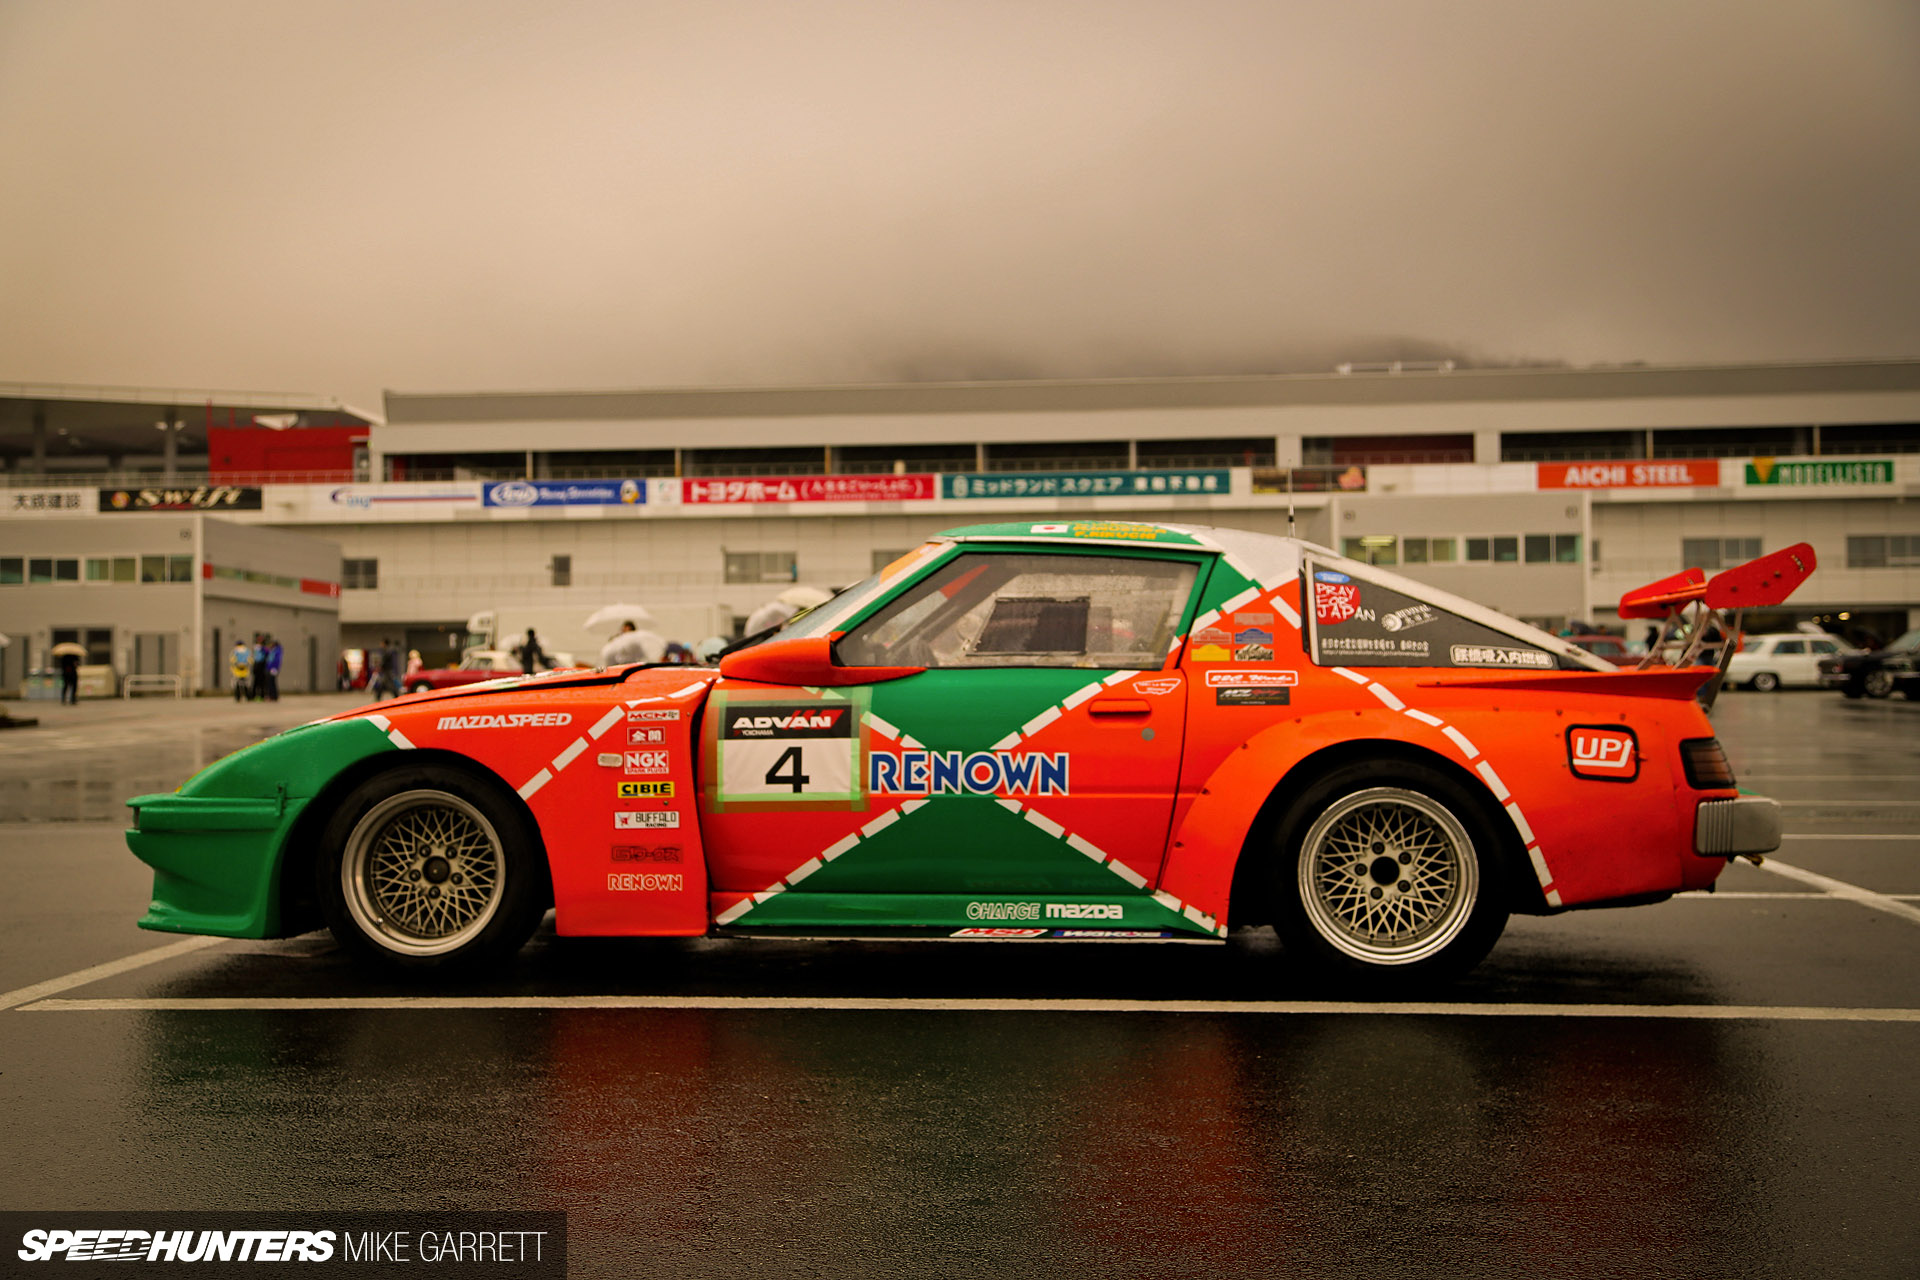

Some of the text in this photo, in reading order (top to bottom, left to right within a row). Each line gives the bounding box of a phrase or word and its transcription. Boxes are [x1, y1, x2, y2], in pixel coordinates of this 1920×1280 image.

[1565, 465, 1689, 486] AICHI STEEL
[1779, 463, 1886, 486] MODELLISTA
[135, 486, 242, 508] Swift
[691, 480, 797, 501] トヨタホーム
[1315, 583, 1355, 599] PRAY
[1316, 595, 1349, 607] FOR
[1317, 605, 1376, 622] JAPAN
[437, 713, 572, 730] MAZDASPEED
[732, 716, 831, 729] ADVAN
[1576, 737, 1623, 759] UP
[626, 753, 667, 768] NGK
[765, 746, 810, 793] 4
[869, 751, 1070, 796] RENOWN
[622, 783, 671, 793] CIBIE
[636, 812, 676, 823] BUFFALO
[607, 873, 683, 891] RENOWN
[966, 902, 1123, 920] CHARGE mazda
